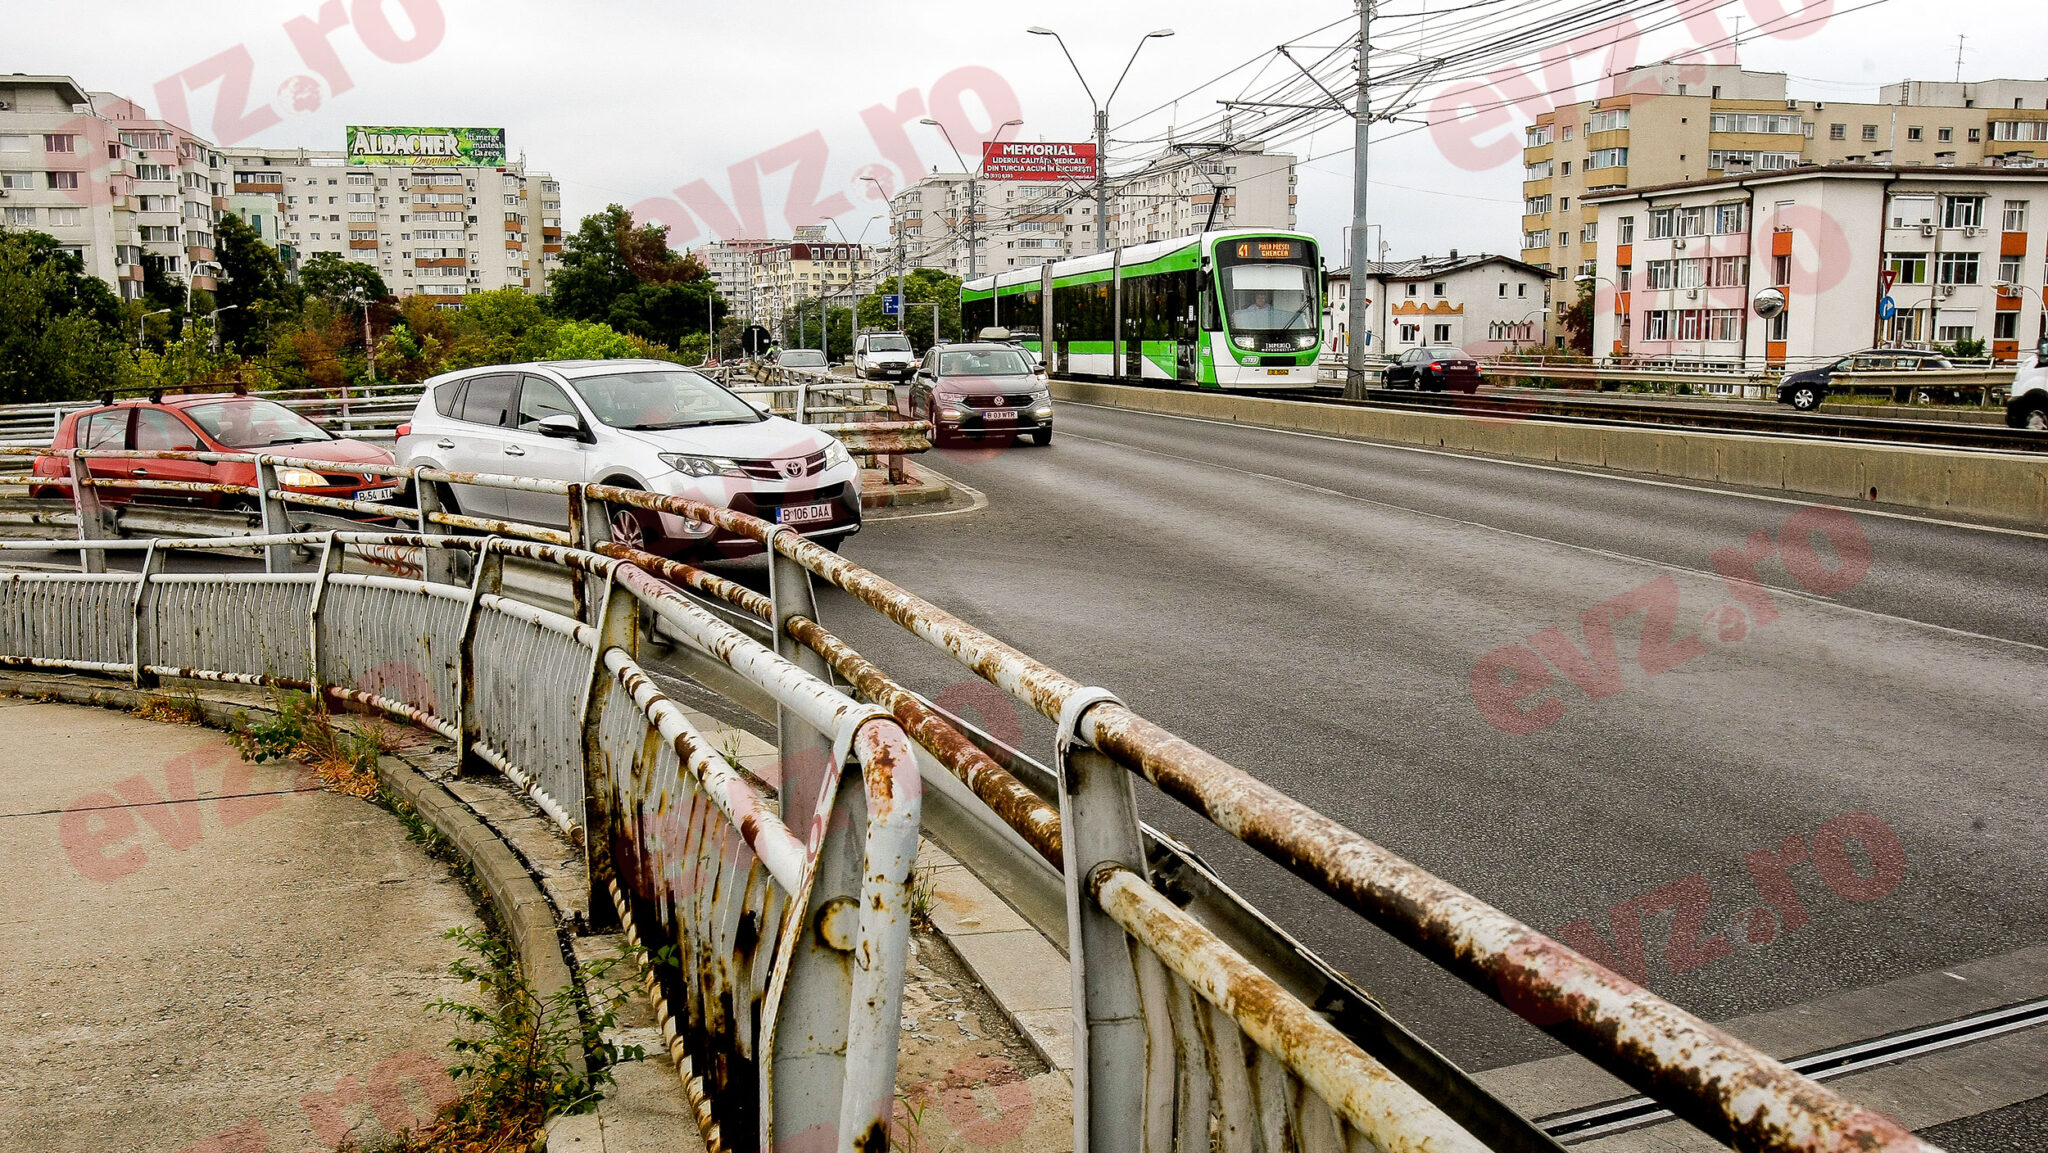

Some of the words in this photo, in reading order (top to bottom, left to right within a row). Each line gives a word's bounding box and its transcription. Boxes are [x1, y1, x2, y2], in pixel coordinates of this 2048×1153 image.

[353, 131, 462, 157] ALBACHER
[1002, 144, 1076, 155] MEMORIAL
[1238, 244, 1249, 257] 41
[358, 492, 365, 501] B
[368, 491, 377, 500] 54
[783, 509, 790, 521] B
[794, 507, 809, 519] 106
[811, 506, 830, 518] DAA
